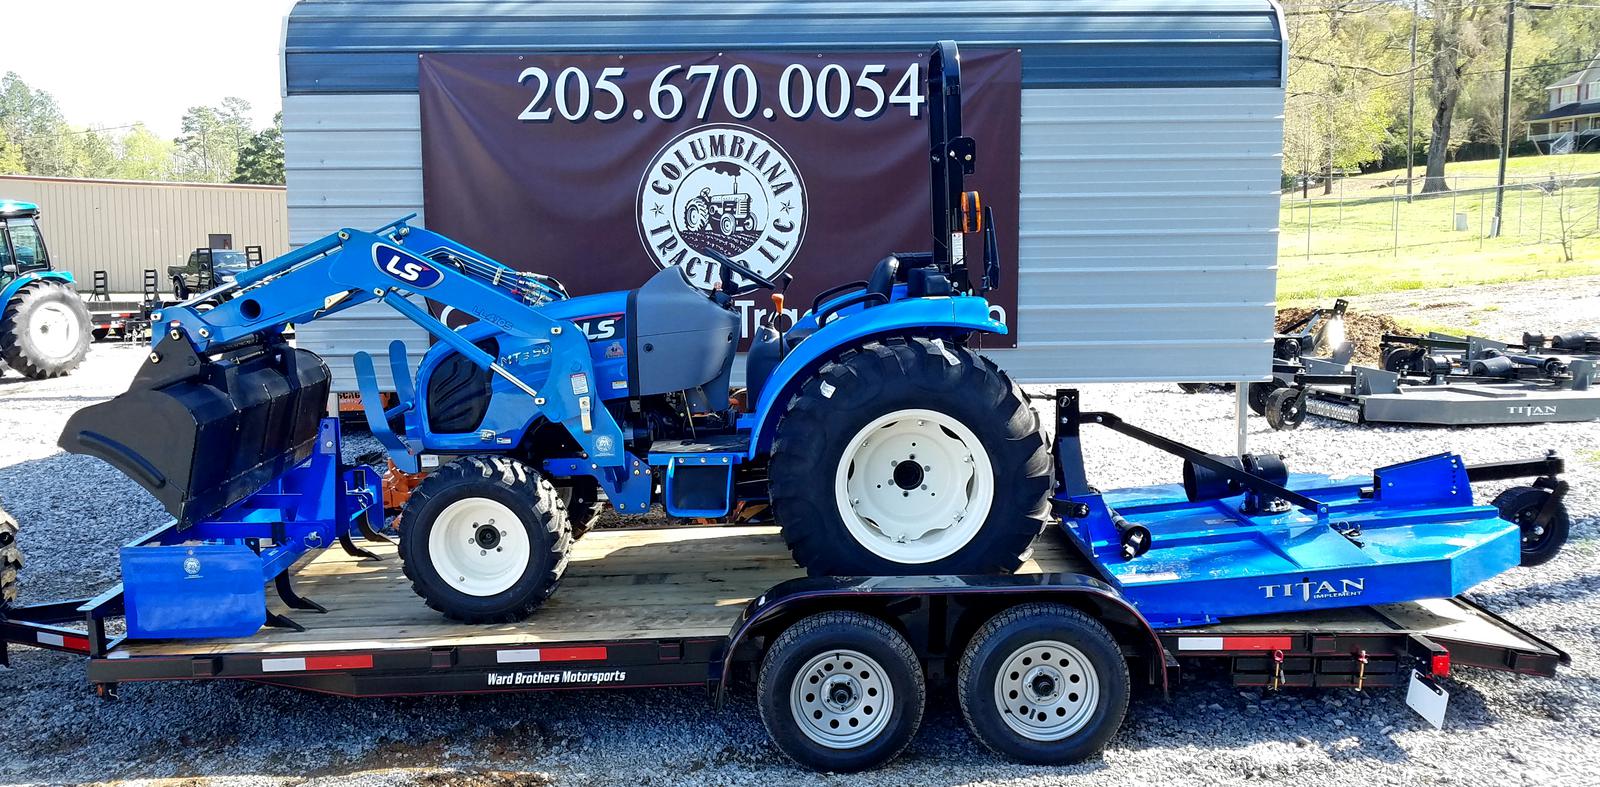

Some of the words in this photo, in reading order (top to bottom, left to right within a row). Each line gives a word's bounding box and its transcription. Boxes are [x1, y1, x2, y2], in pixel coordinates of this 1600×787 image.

[517, 63, 925, 121] 205.670.0054
[651, 134, 794, 197] COLUMBIANA
[757, 218, 795, 264] LLC
[386, 255, 423, 282] LS
[582, 320, 615, 340] LS
[1506, 405, 1556, 416] TITAN
[1258, 578, 1366, 602] TITAN
[1314, 591, 1362, 599] IMPLEMENT
[488, 673, 514, 685] Ward
[515, 672, 560, 684] Brothers
[561, 670, 626, 684] Motorsports
